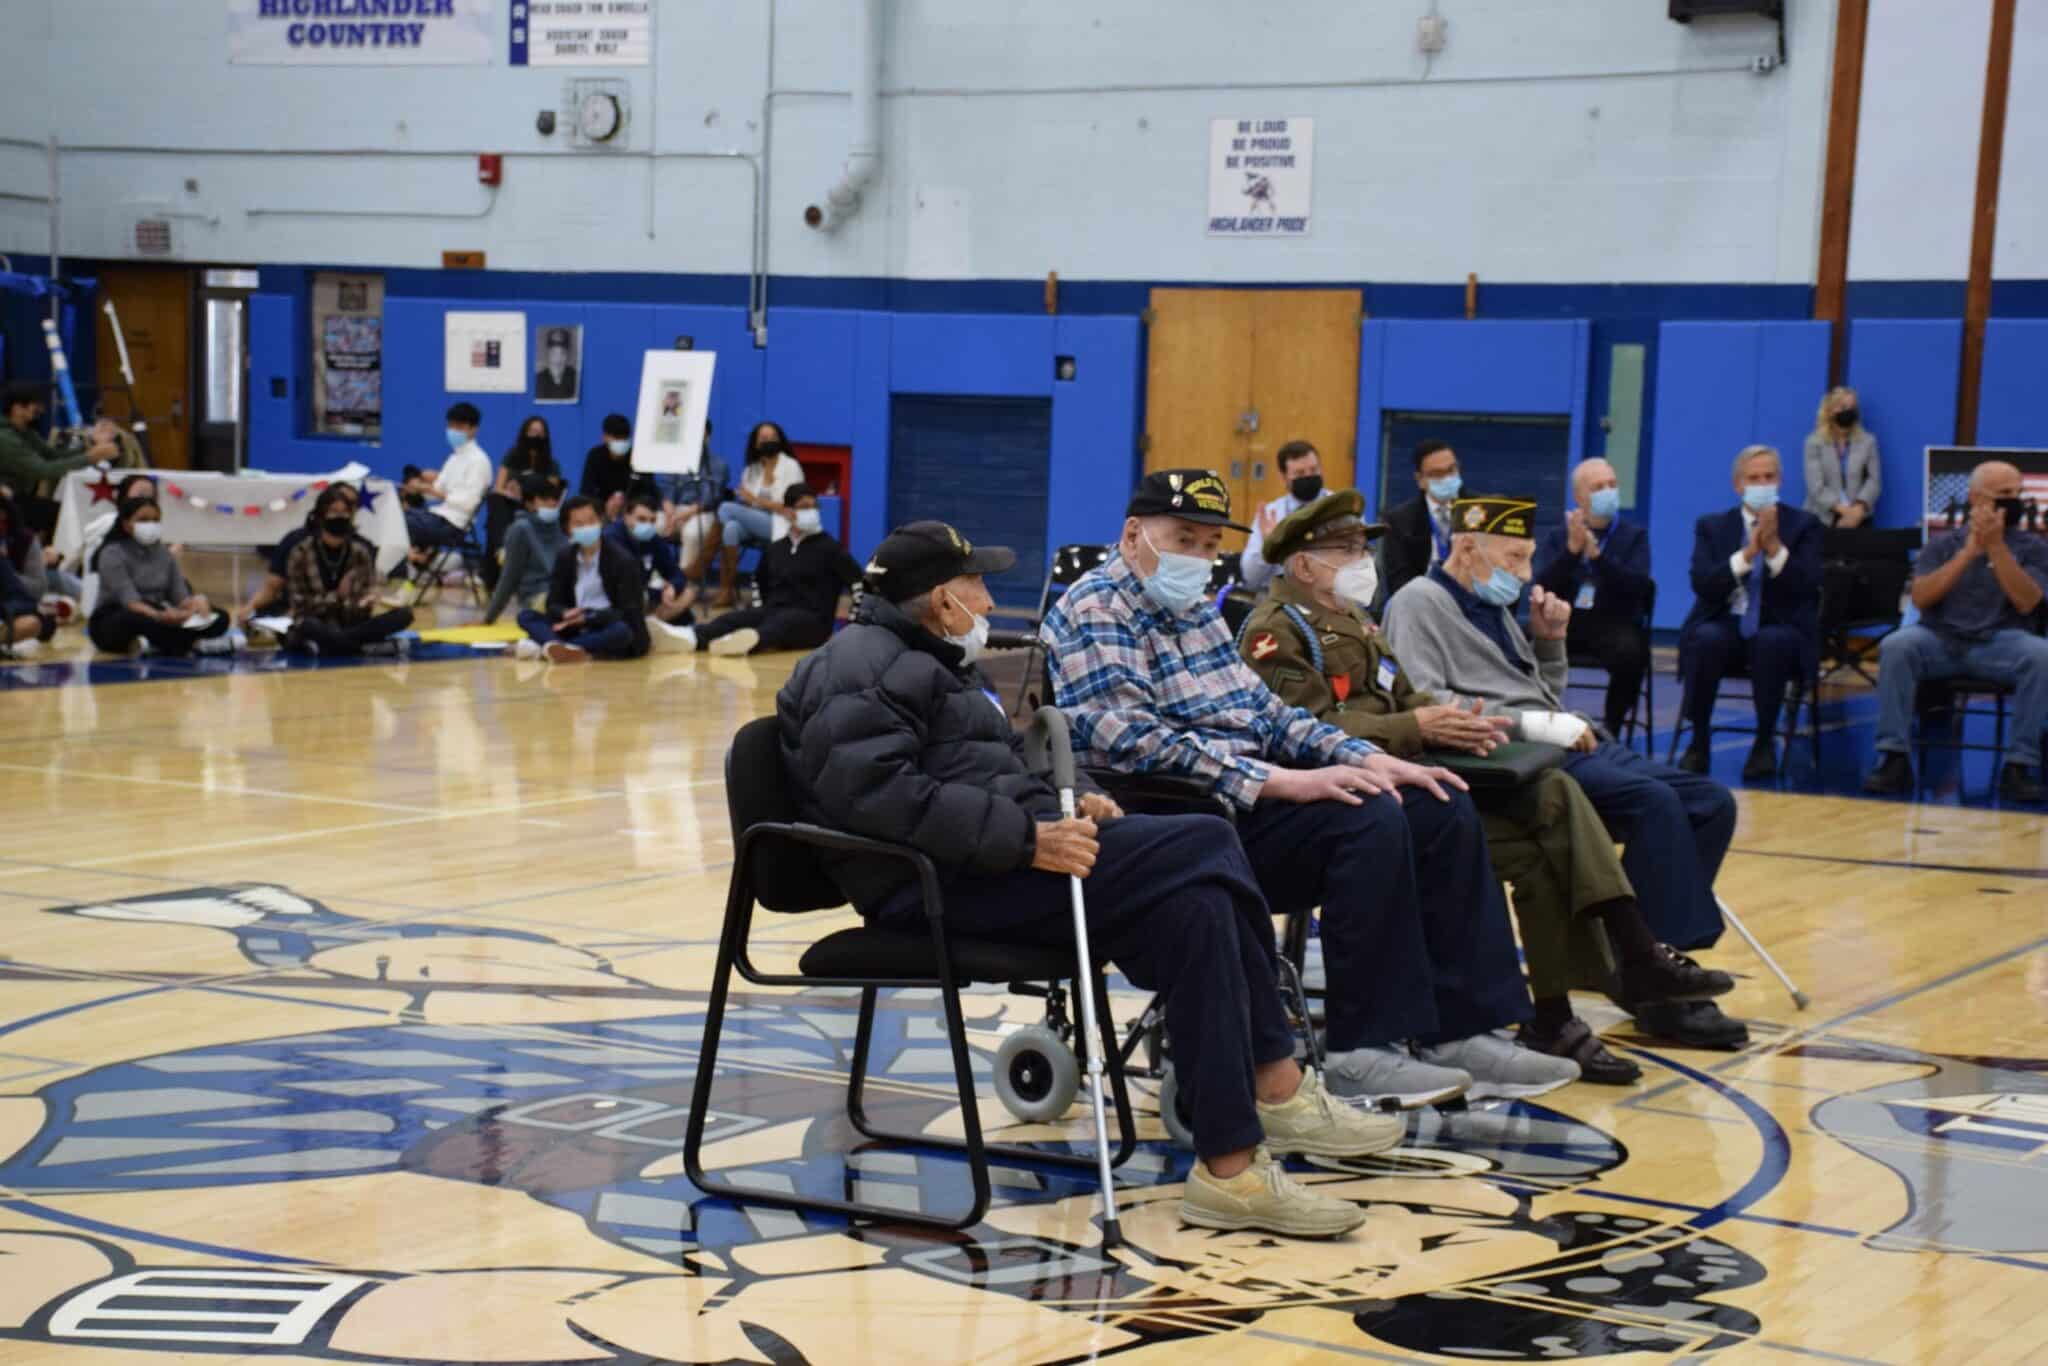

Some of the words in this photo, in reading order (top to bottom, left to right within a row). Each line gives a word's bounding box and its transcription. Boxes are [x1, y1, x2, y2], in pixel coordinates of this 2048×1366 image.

[258, 0, 455, 17] HIGHLANDER
[287, 23, 425, 46] COUNTRY
[1238, 121, 1250, 133] BE
[1256, 121, 1287, 133] LOUD
[1233, 138, 1246, 150] BE
[1251, 138, 1290, 150] PROUD
[1226, 156, 1239, 168] BE
[1245, 155, 1295, 168] POSITIVE
[1209, 217, 1273, 232] HIGHLANDER
[1277, 217, 1306, 232] PRIDE
